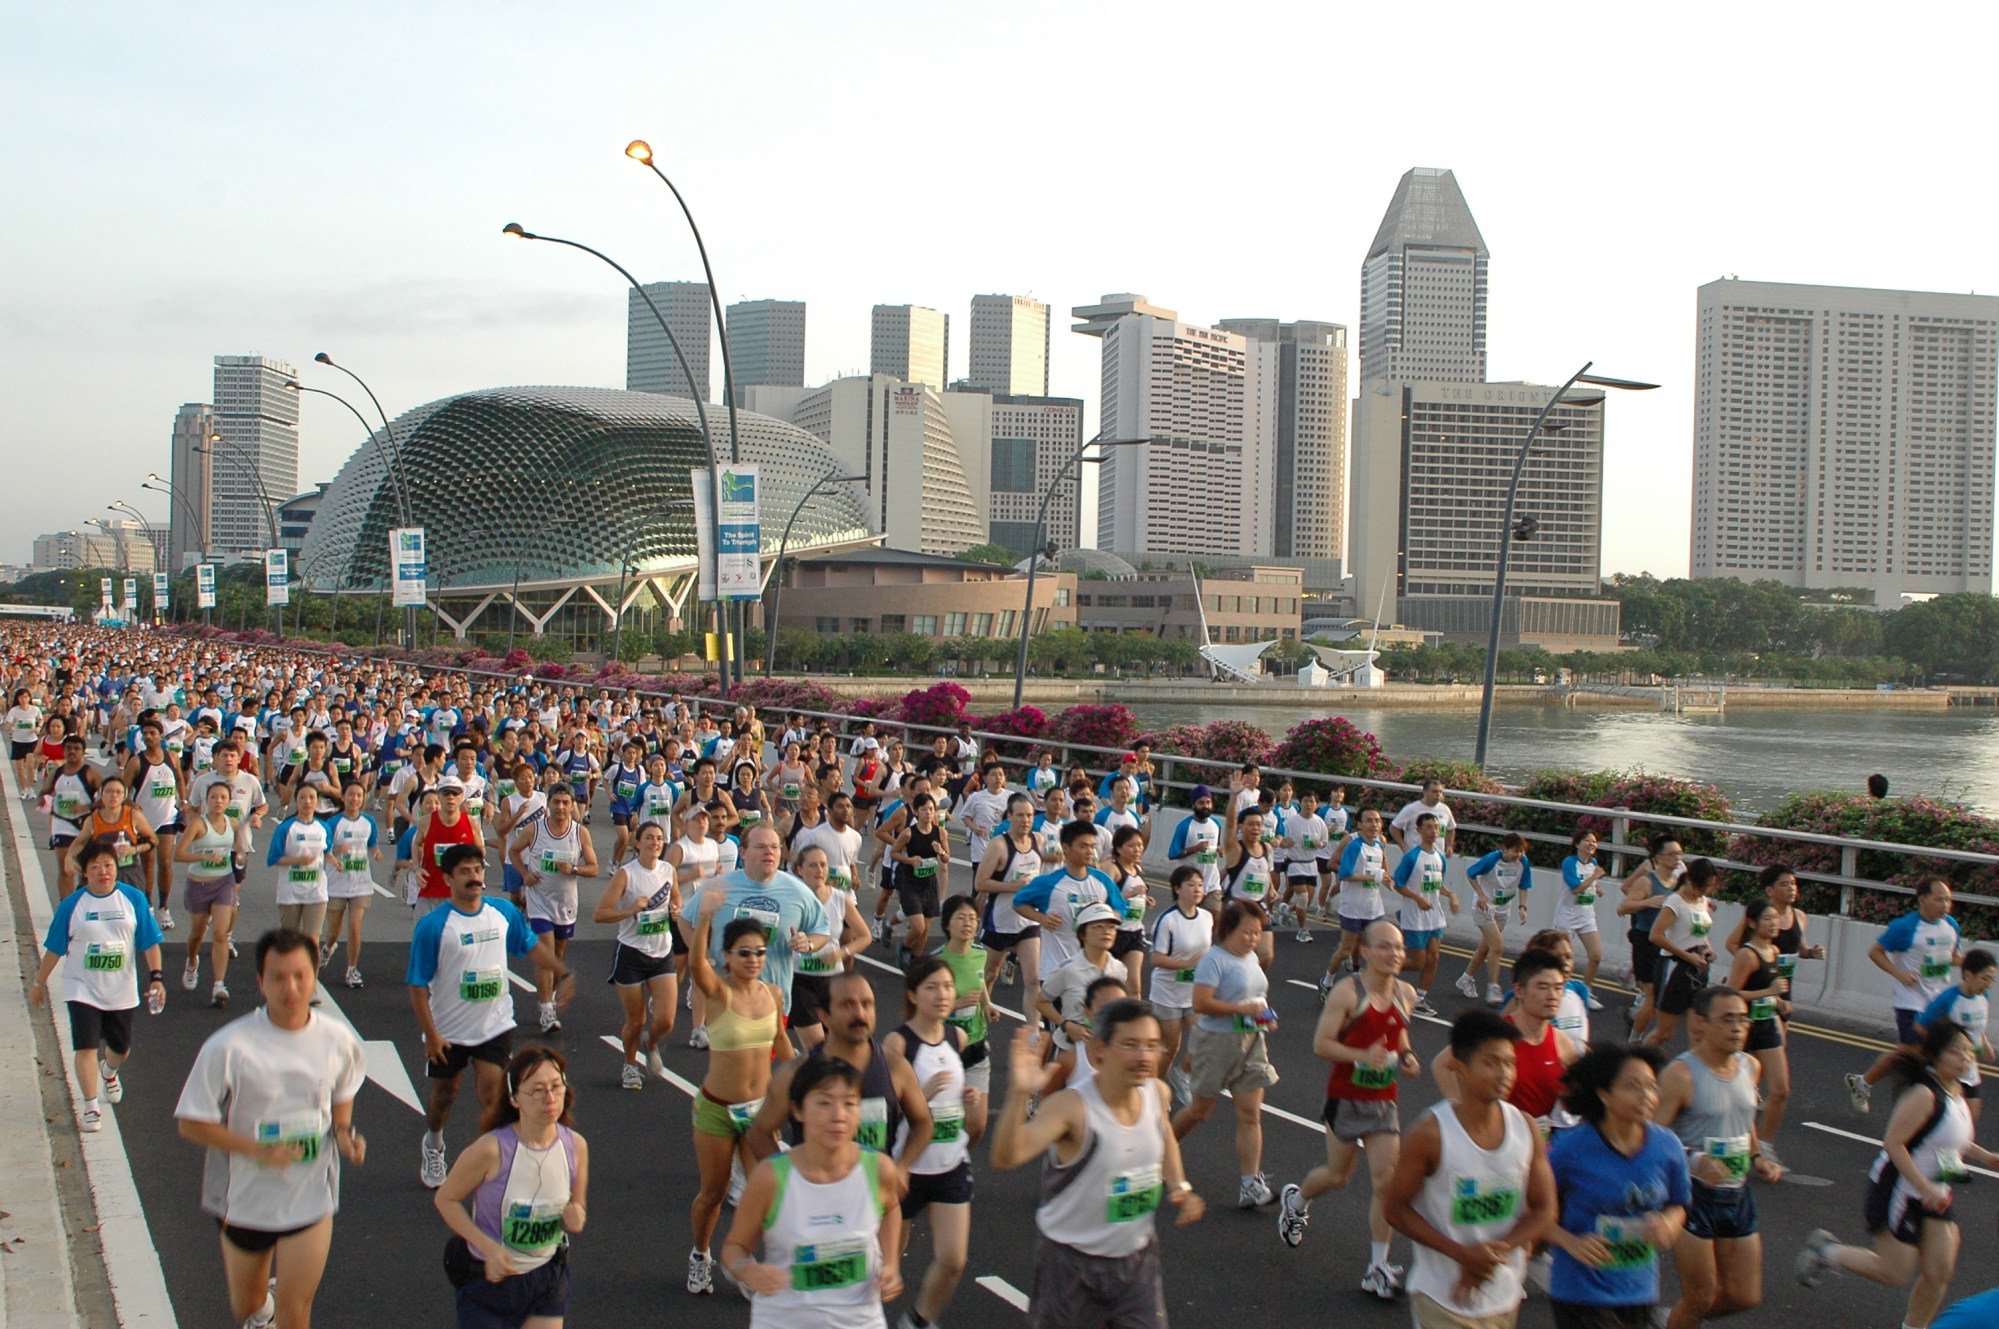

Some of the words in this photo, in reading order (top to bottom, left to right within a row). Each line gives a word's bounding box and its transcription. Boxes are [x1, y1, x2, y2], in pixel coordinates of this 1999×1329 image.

[1442, 388, 1472, 399] THE
[1485, 390, 1553, 402] ORIENT
[724, 531, 737, 539] The
[738, 531, 754, 540] Spirit
[732, 539, 757, 548] Triumph
[89, 955, 122, 969] 10750
[467, 982, 498, 999] 10196
